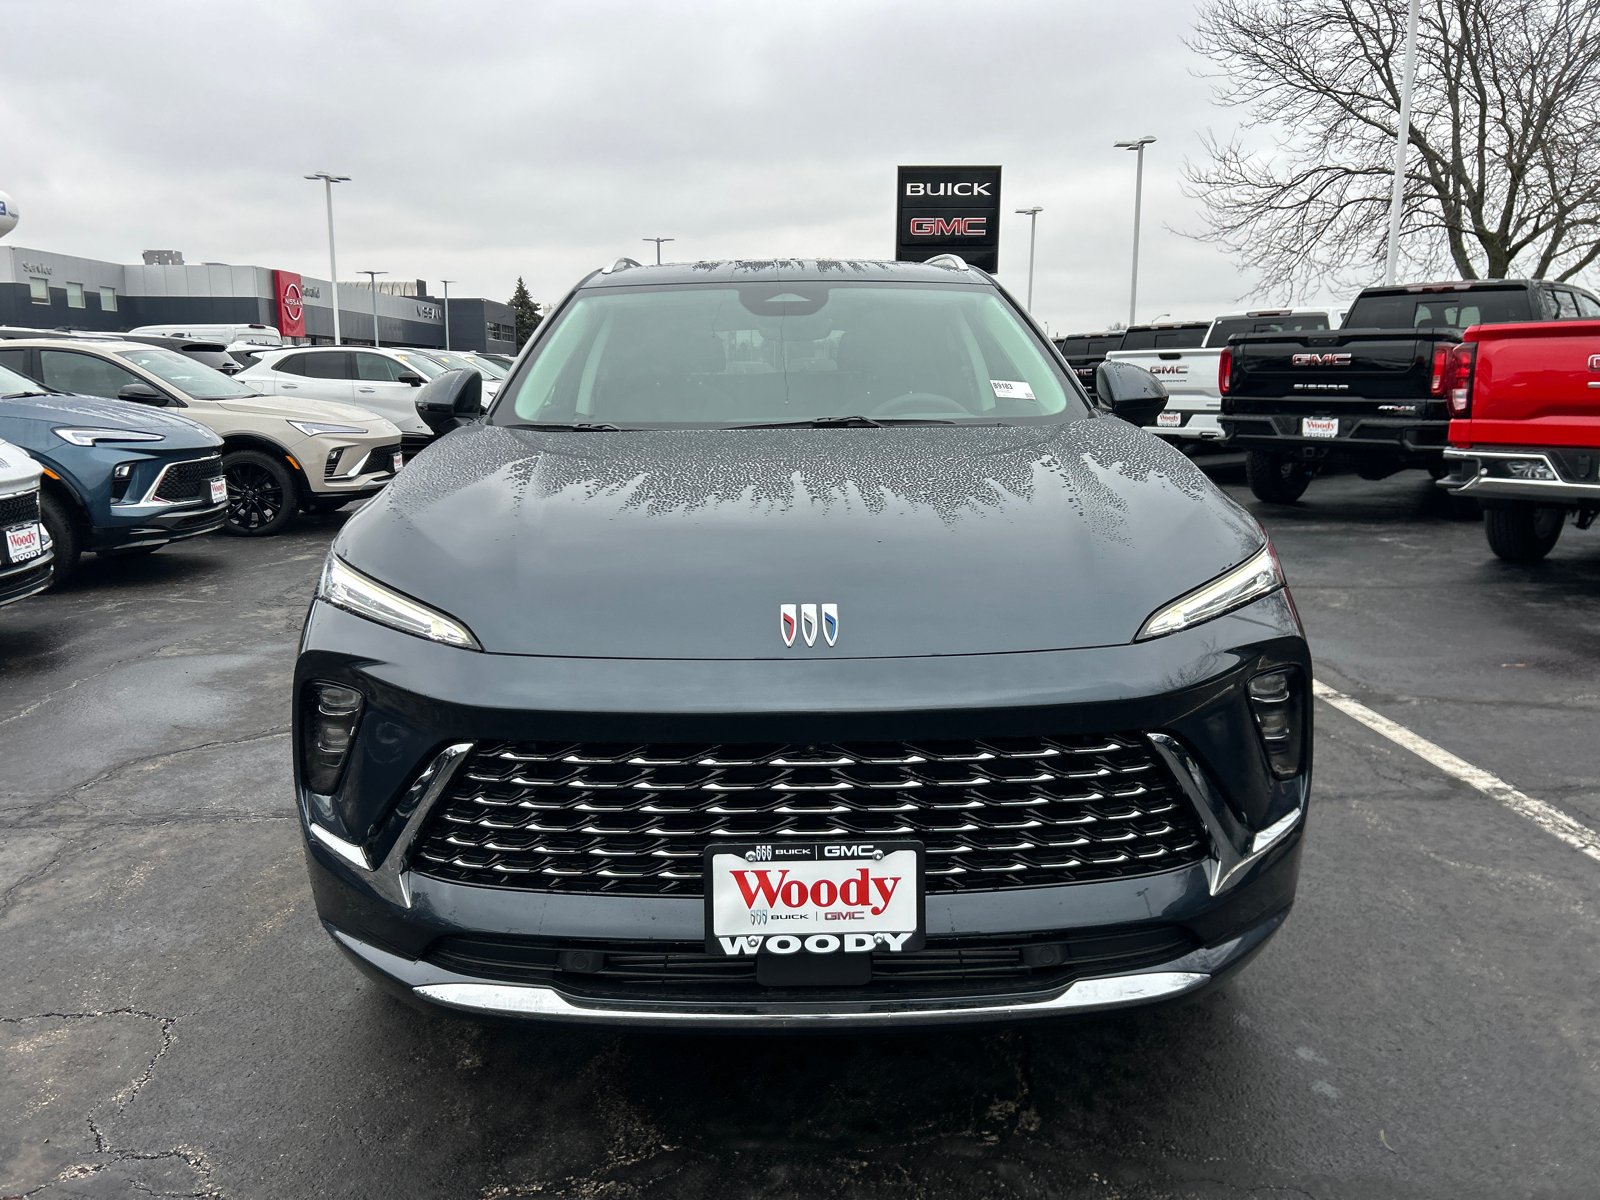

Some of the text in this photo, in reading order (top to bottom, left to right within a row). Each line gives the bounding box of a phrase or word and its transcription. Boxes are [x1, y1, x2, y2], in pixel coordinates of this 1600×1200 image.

[906, 182, 992, 196] BUICK
[910, 217, 987, 236] GMC
[416, 305, 442, 320] NISSAN
[1292, 353, 1352, 366] GMC
[1149, 364, 1189, 375] GMC
[1306, 421, 1336, 431] Woody
[9, 531, 36, 547] Woody
[12, 549, 42, 563] WOODY
[824, 845, 874, 857] GMC
[729, 868, 901, 916] Woody
[824, 911, 865, 921] GMC
[718, 933, 913, 955] WOODY
